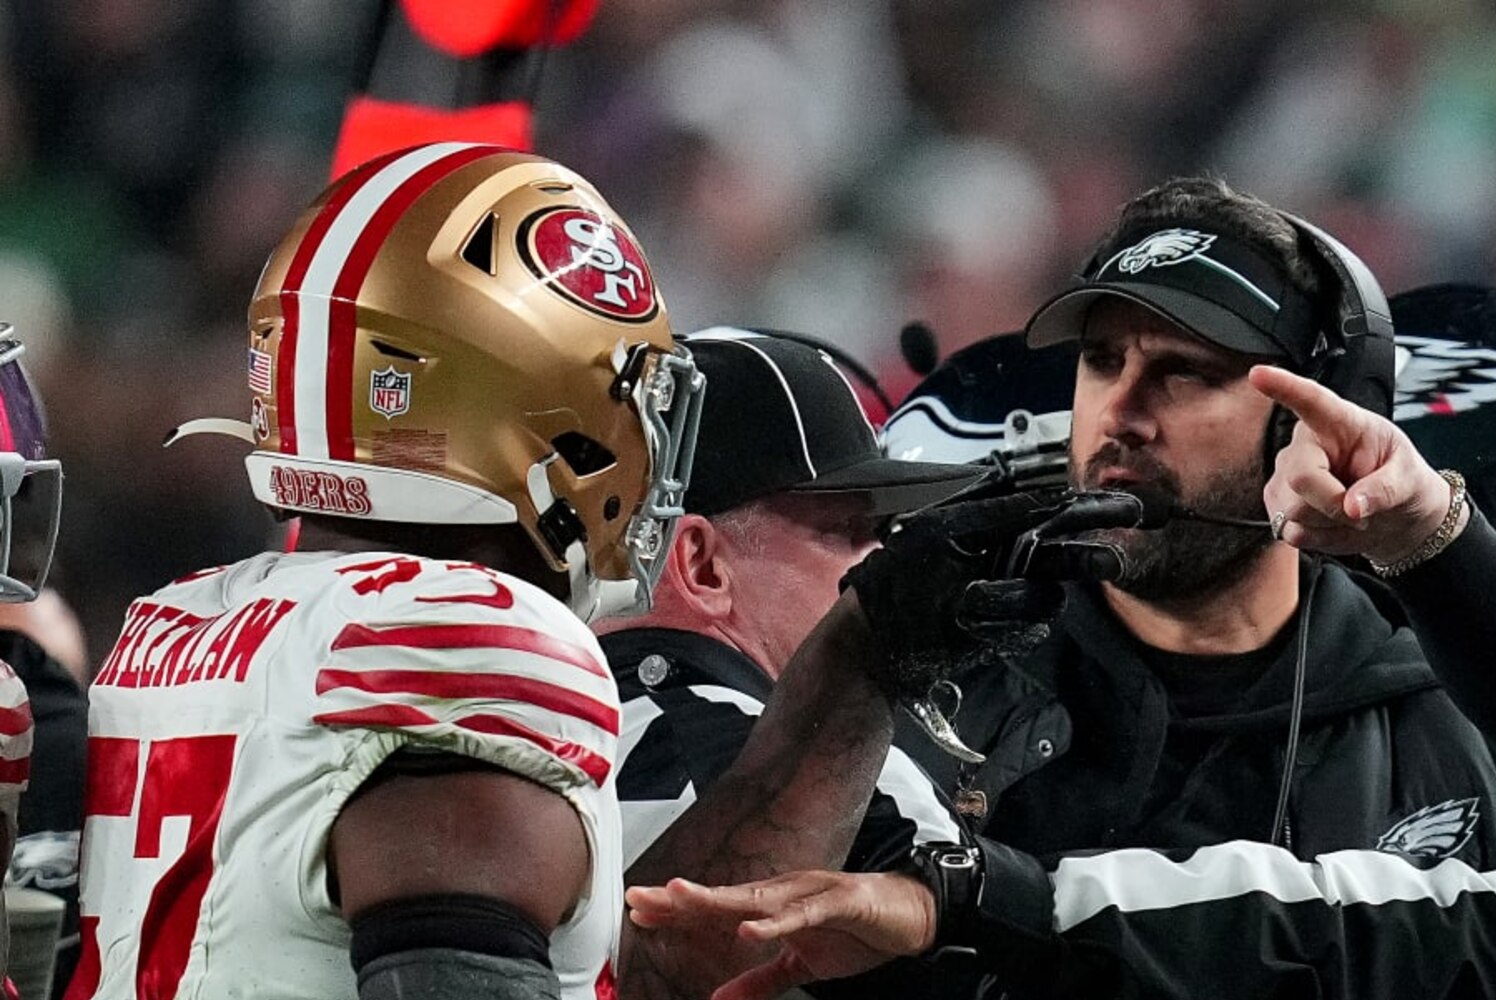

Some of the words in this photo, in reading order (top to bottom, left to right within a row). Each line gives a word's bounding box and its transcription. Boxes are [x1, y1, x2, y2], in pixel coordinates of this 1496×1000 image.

[374, 388, 403, 410] NFL
[270, 466, 373, 516] 49ERS
[95, 597, 298, 689] REENLAW
